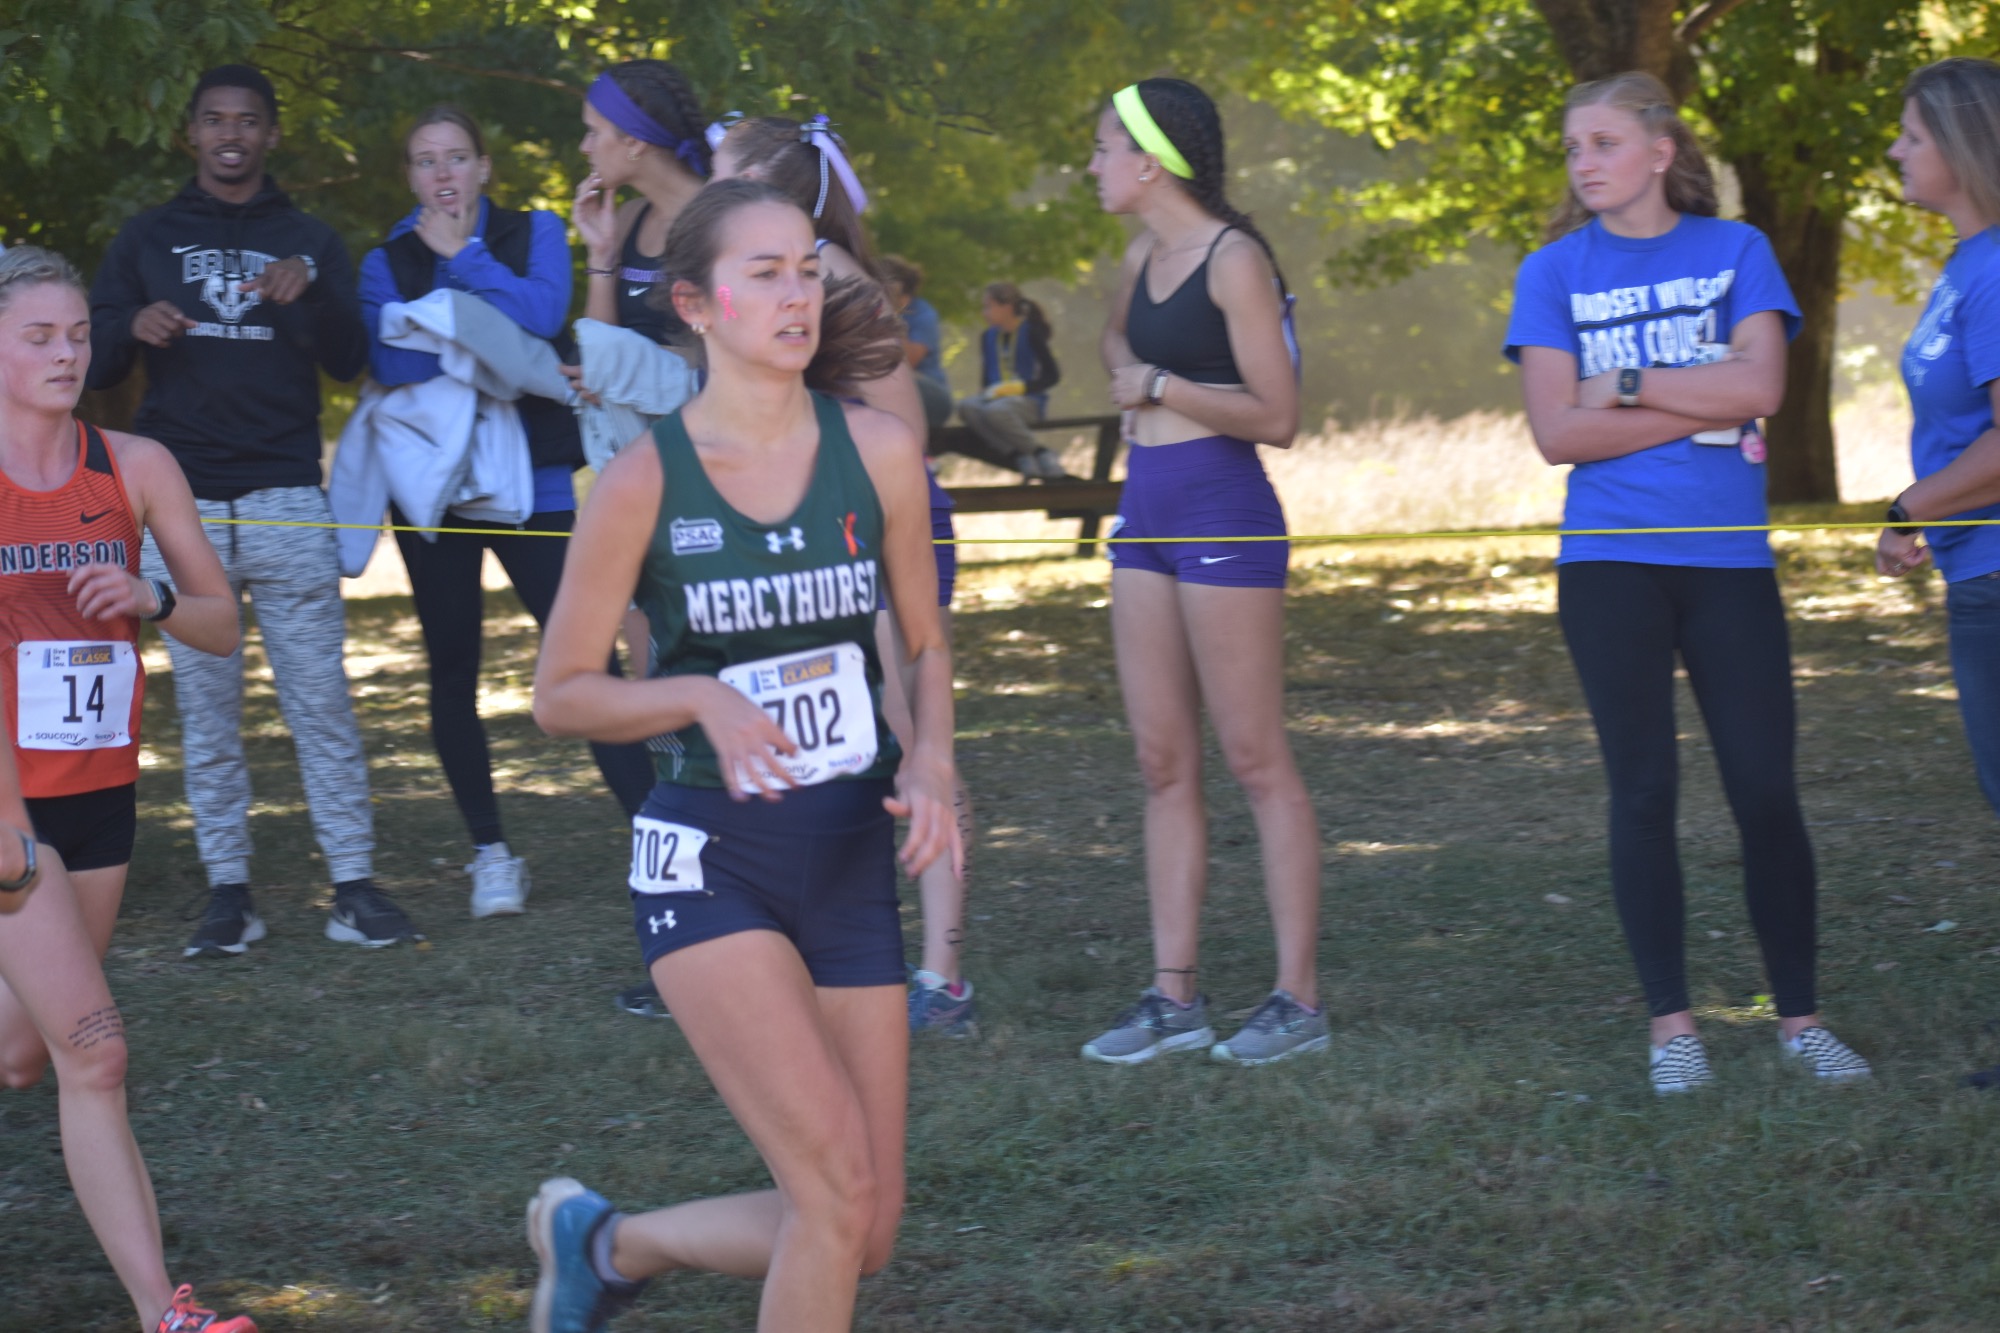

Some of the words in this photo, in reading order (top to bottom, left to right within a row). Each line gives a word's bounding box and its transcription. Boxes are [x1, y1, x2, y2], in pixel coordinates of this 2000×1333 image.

[683, 560, 877, 633] MERCYHURST
[72, 653, 112, 665] CLASSIC
[62, 675, 104, 723] 14
[762, 688, 845, 756] 702
[35, 732, 79, 741] saucony
[635, 828, 679, 881] 702
